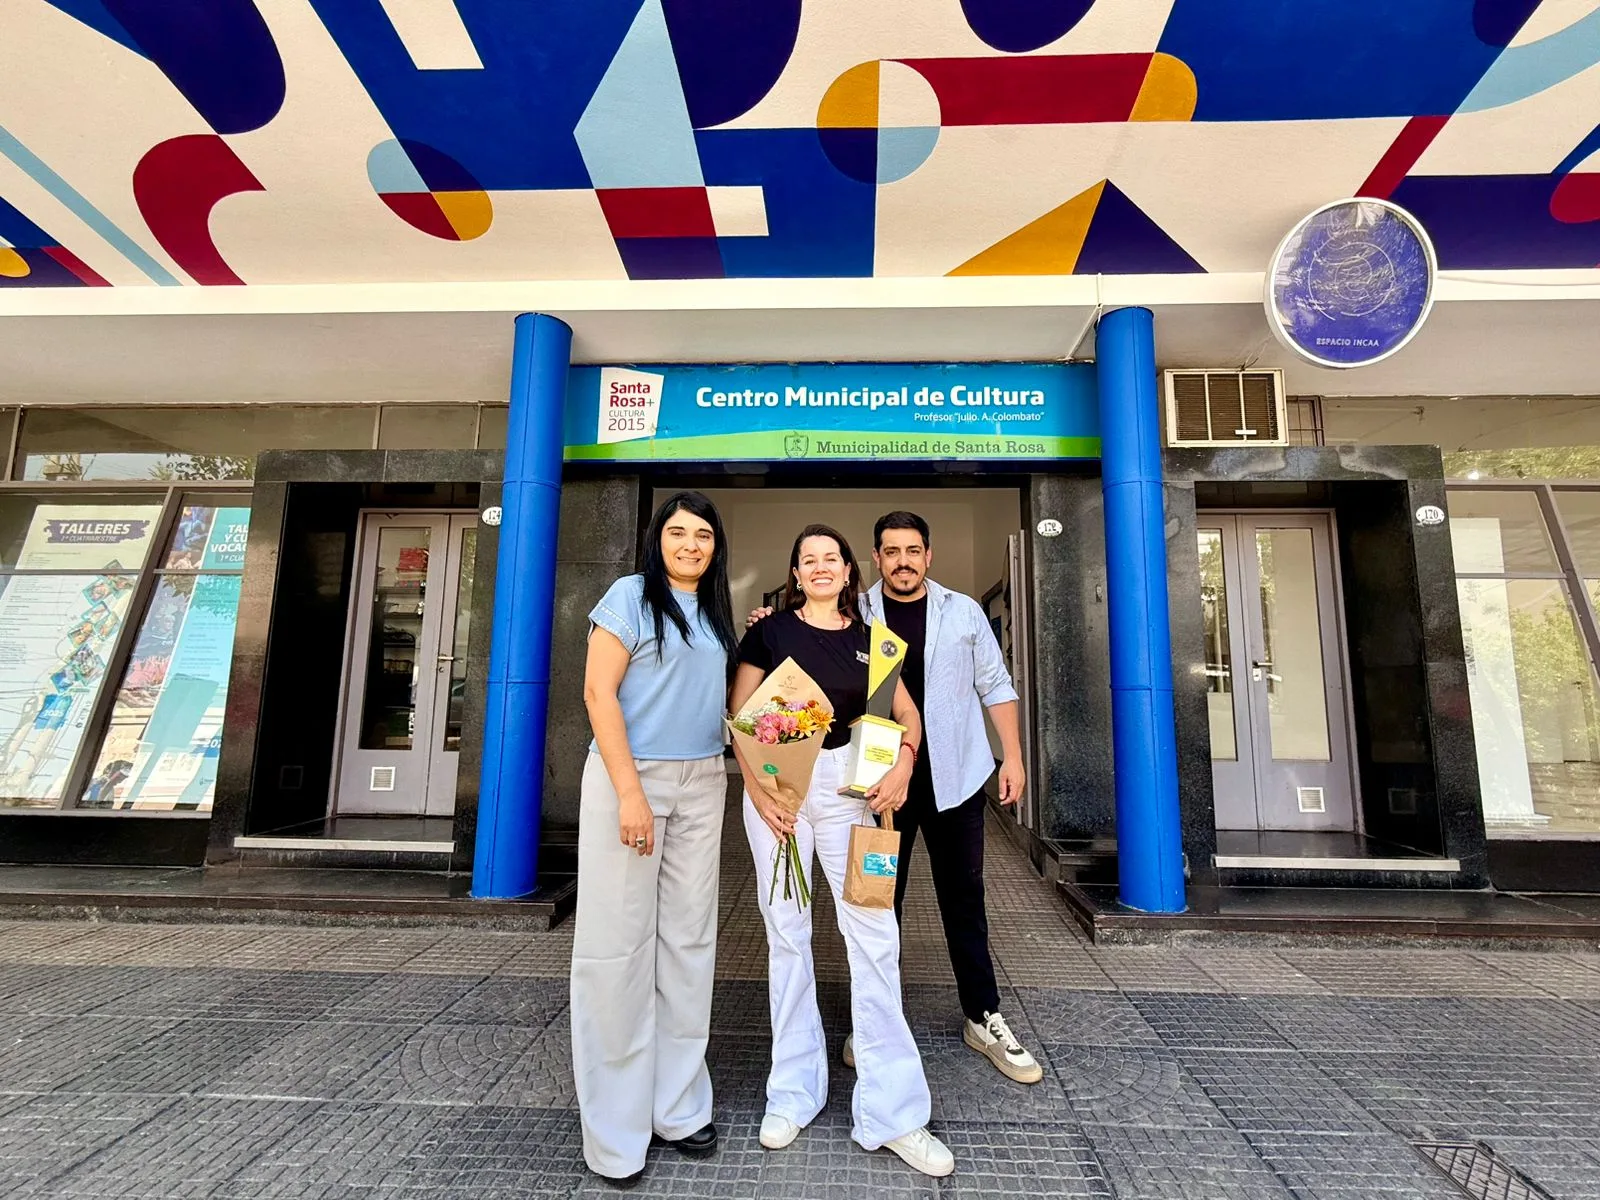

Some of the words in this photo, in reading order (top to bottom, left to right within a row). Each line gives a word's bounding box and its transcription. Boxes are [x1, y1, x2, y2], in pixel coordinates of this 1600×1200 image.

[1316, 337, 1351, 346] ESPACIO
[1353, 339, 1379, 347] INCAA
[610, 381, 651, 394] Santa
[696, 386, 779, 407] Centro
[784, 386, 908, 410] Municipal
[913, 386, 945, 406] de
[950, 385, 1045, 406] Cultura
[608, 409, 645, 418] CULTURA
[914, 412, 952, 422] Profesor
[608, 418, 645, 431] 2015
[816, 441, 929, 457] Municipalidad
[932, 441, 951, 454] de
[955, 441, 1001, 454] Santa
[1005, 441, 1046, 454] Rosa
[1424, 509, 1439, 519] 170
[59, 523, 131, 535] TALLERES
[224, 534, 233, 543] Y
